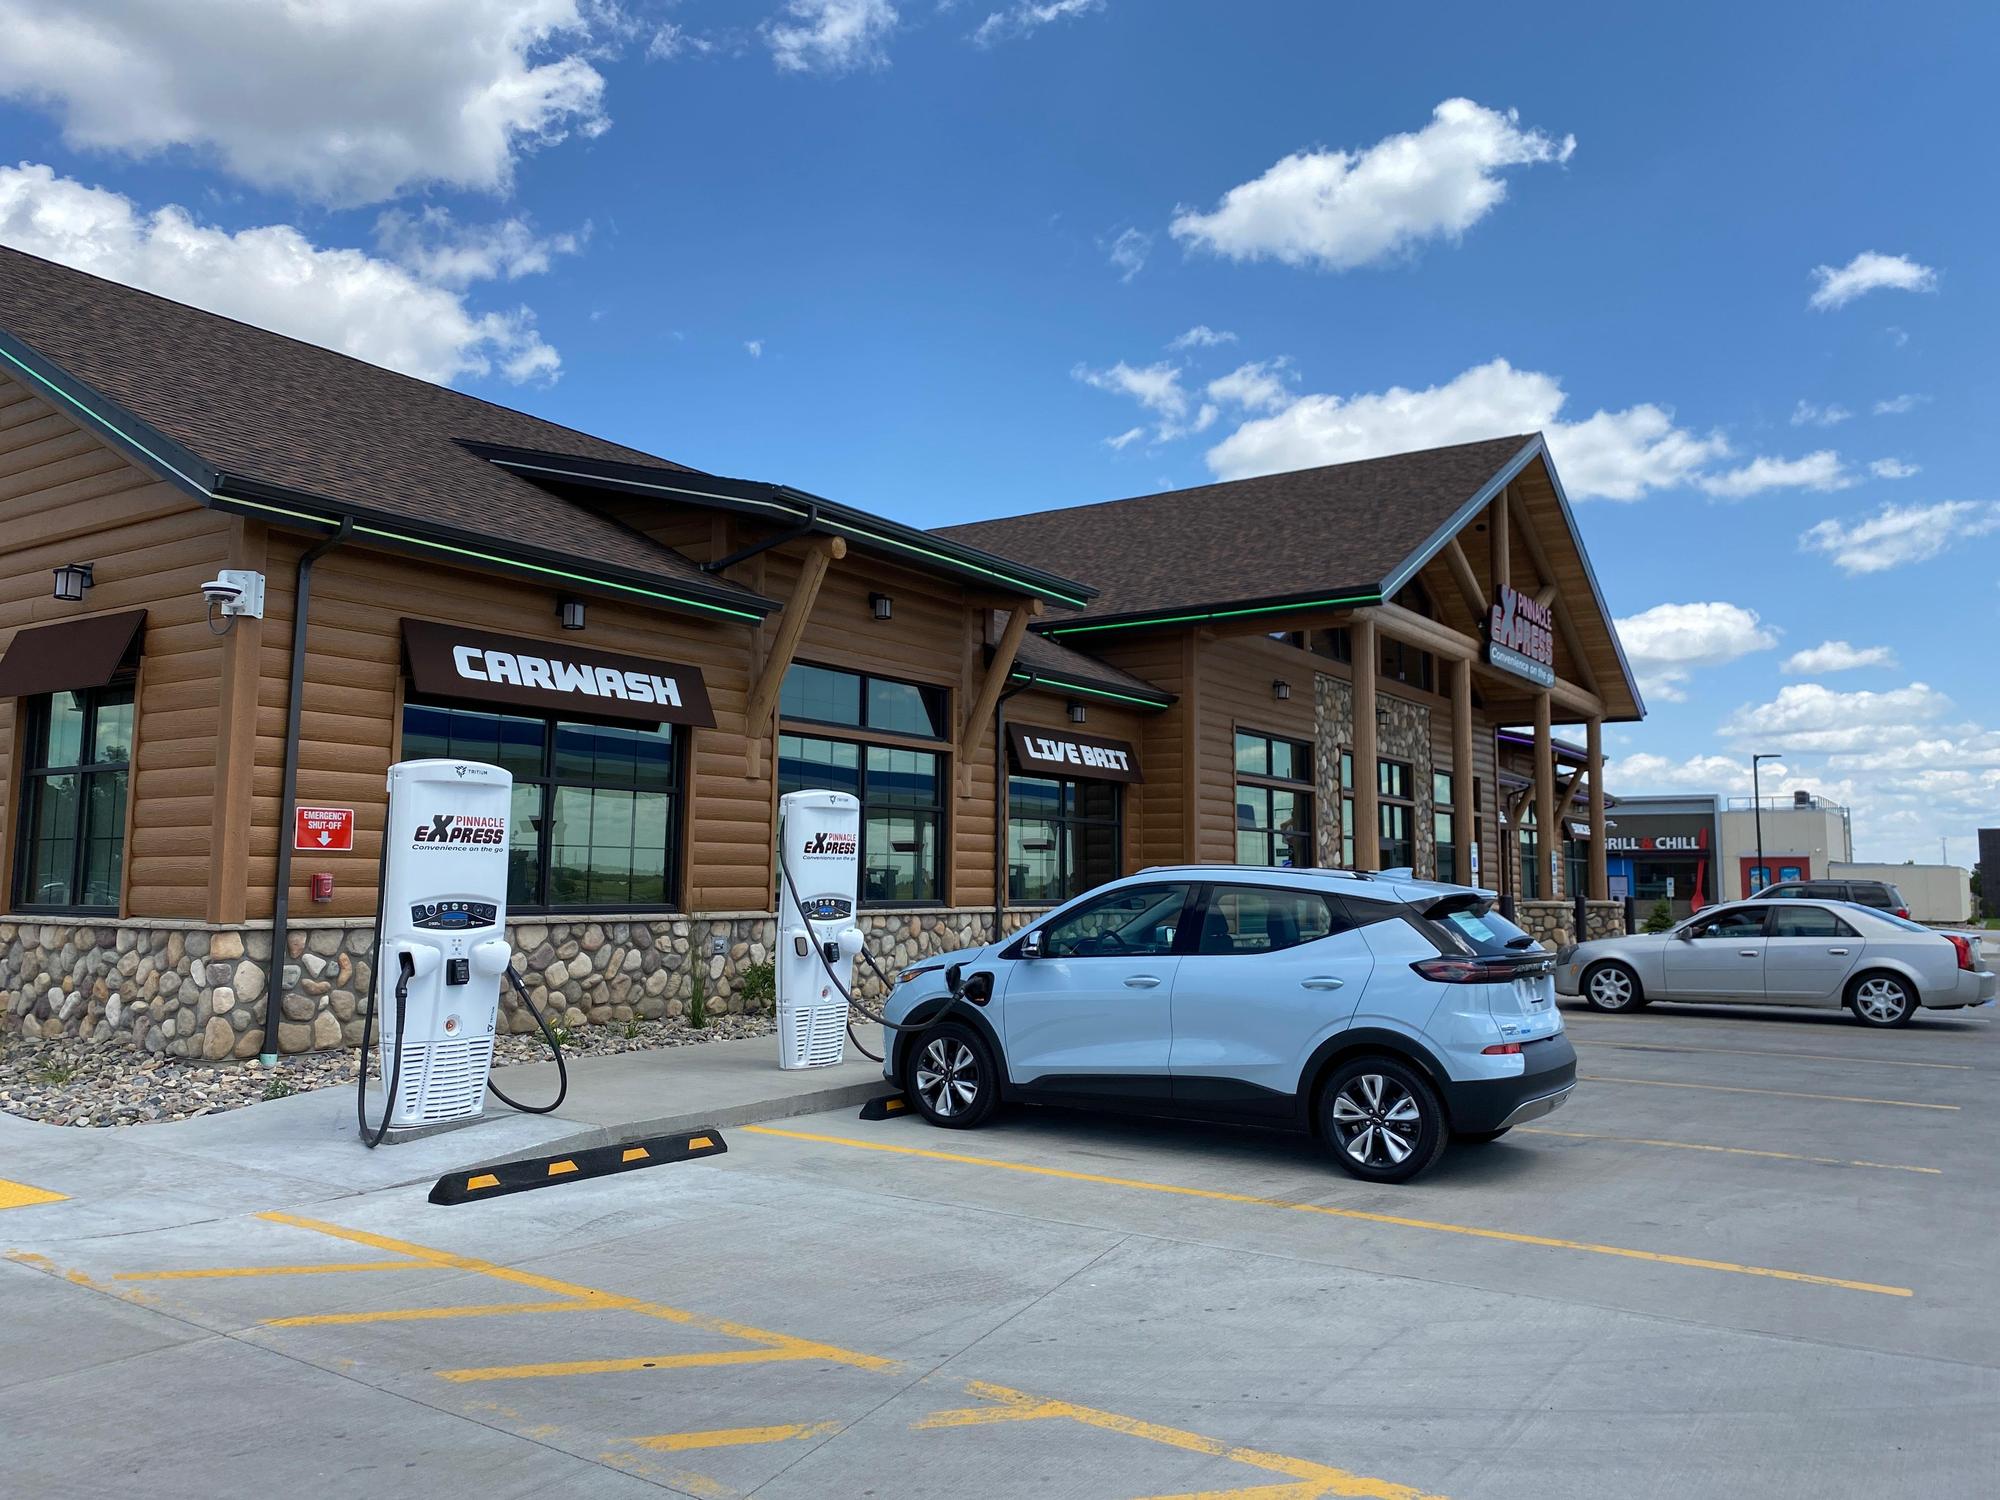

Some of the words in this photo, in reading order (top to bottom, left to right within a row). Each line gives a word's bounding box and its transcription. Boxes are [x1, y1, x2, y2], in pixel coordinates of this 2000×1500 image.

[1517, 591, 1553, 631] PINNACLE
[1491, 646, 1530, 674] Convenience
[1529, 664, 1538, 676] on
[1537, 667, 1547, 680] the
[452, 645, 683, 708] CARWASH
[1023, 735, 1082, 765] LIVE
[1079, 744, 1129, 771] BAIT
[468, 768, 488, 776] TRITIUM
[303, 810, 348, 821] EMERGENCY
[455, 815, 505, 828] PINNACLE
[307, 820, 343, 830] SHUT-OFF
[828, 832, 857, 842] PINNACLE
[1655, 836, 1700, 850] CHILL
[411, 843, 468, 852] Convenience
